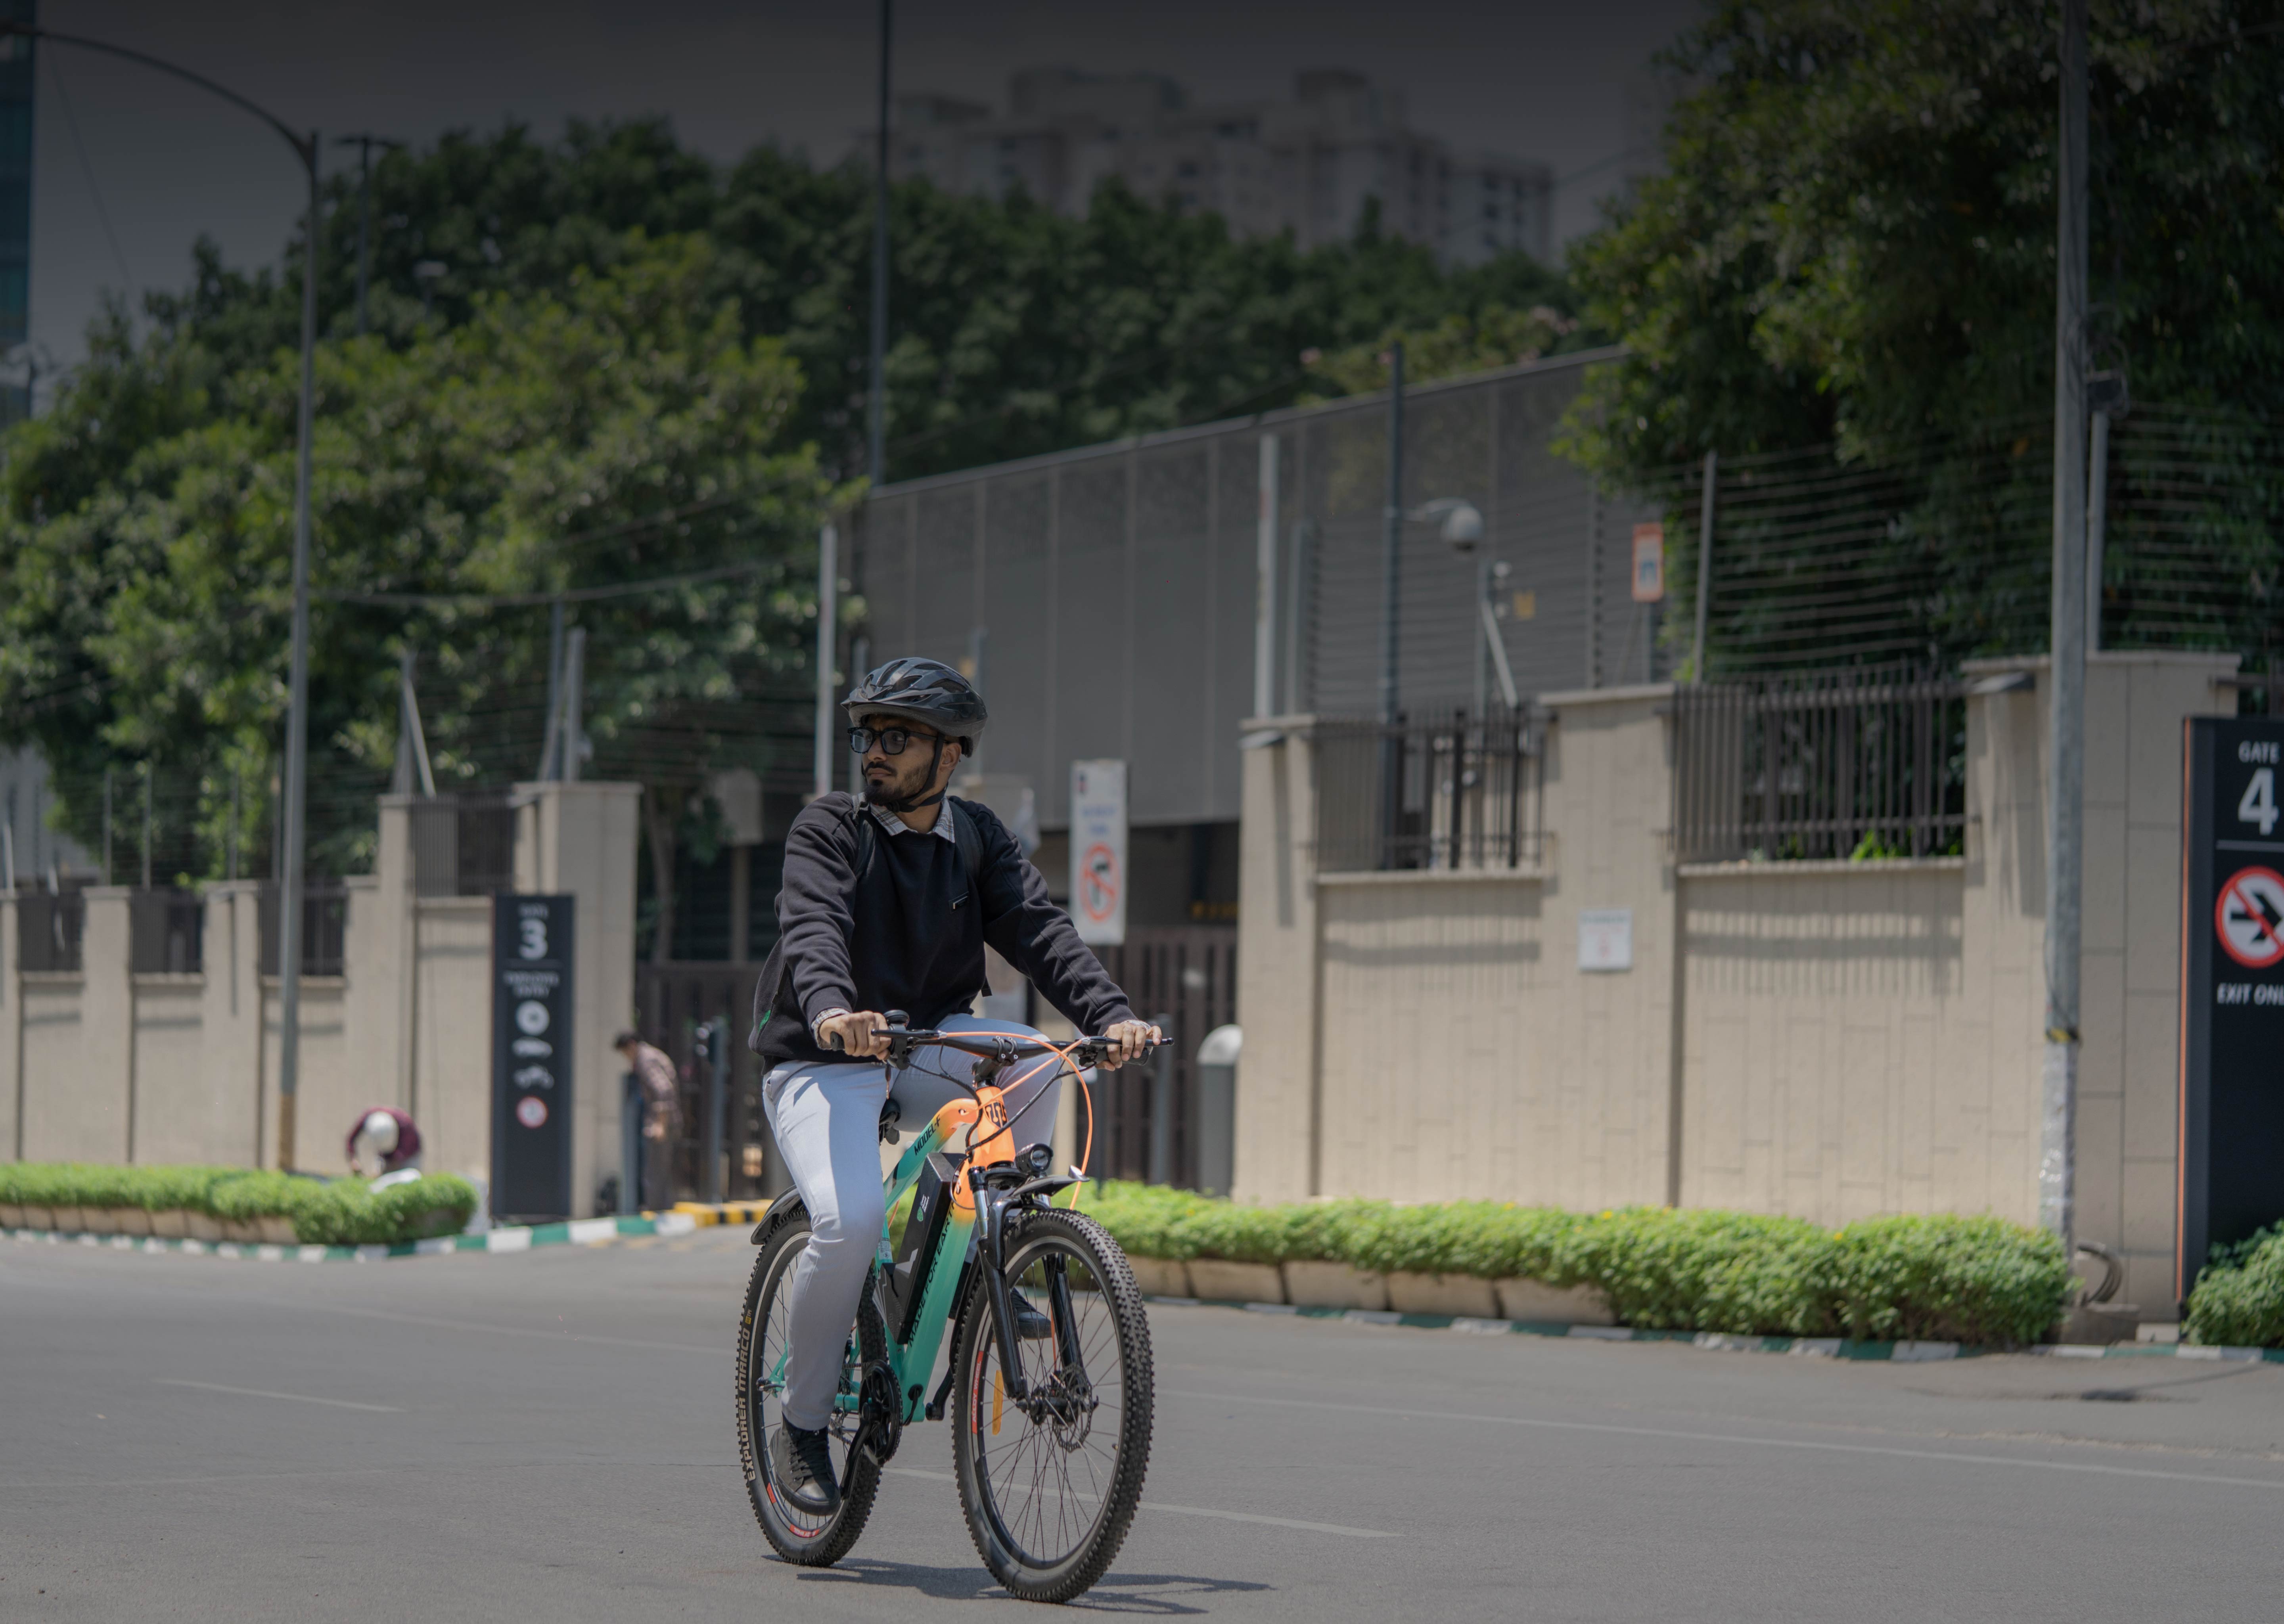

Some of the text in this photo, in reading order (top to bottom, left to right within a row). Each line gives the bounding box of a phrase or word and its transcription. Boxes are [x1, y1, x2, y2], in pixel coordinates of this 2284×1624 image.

[2238, 740, 2280, 764] GATE
[2238, 767, 2279, 835] 4
[519, 917, 548, 961] 3
[2217, 982, 2252, 1005] EXIT
[914, 1114, 940, 1156] MODEL-F
[908, 1300, 925, 1347] MADE
[925, 1257, 938, 1294] FOR
[739, 1328, 750, 1391] MARCO
[739, 1397, 756, 1481] EXPLORER
